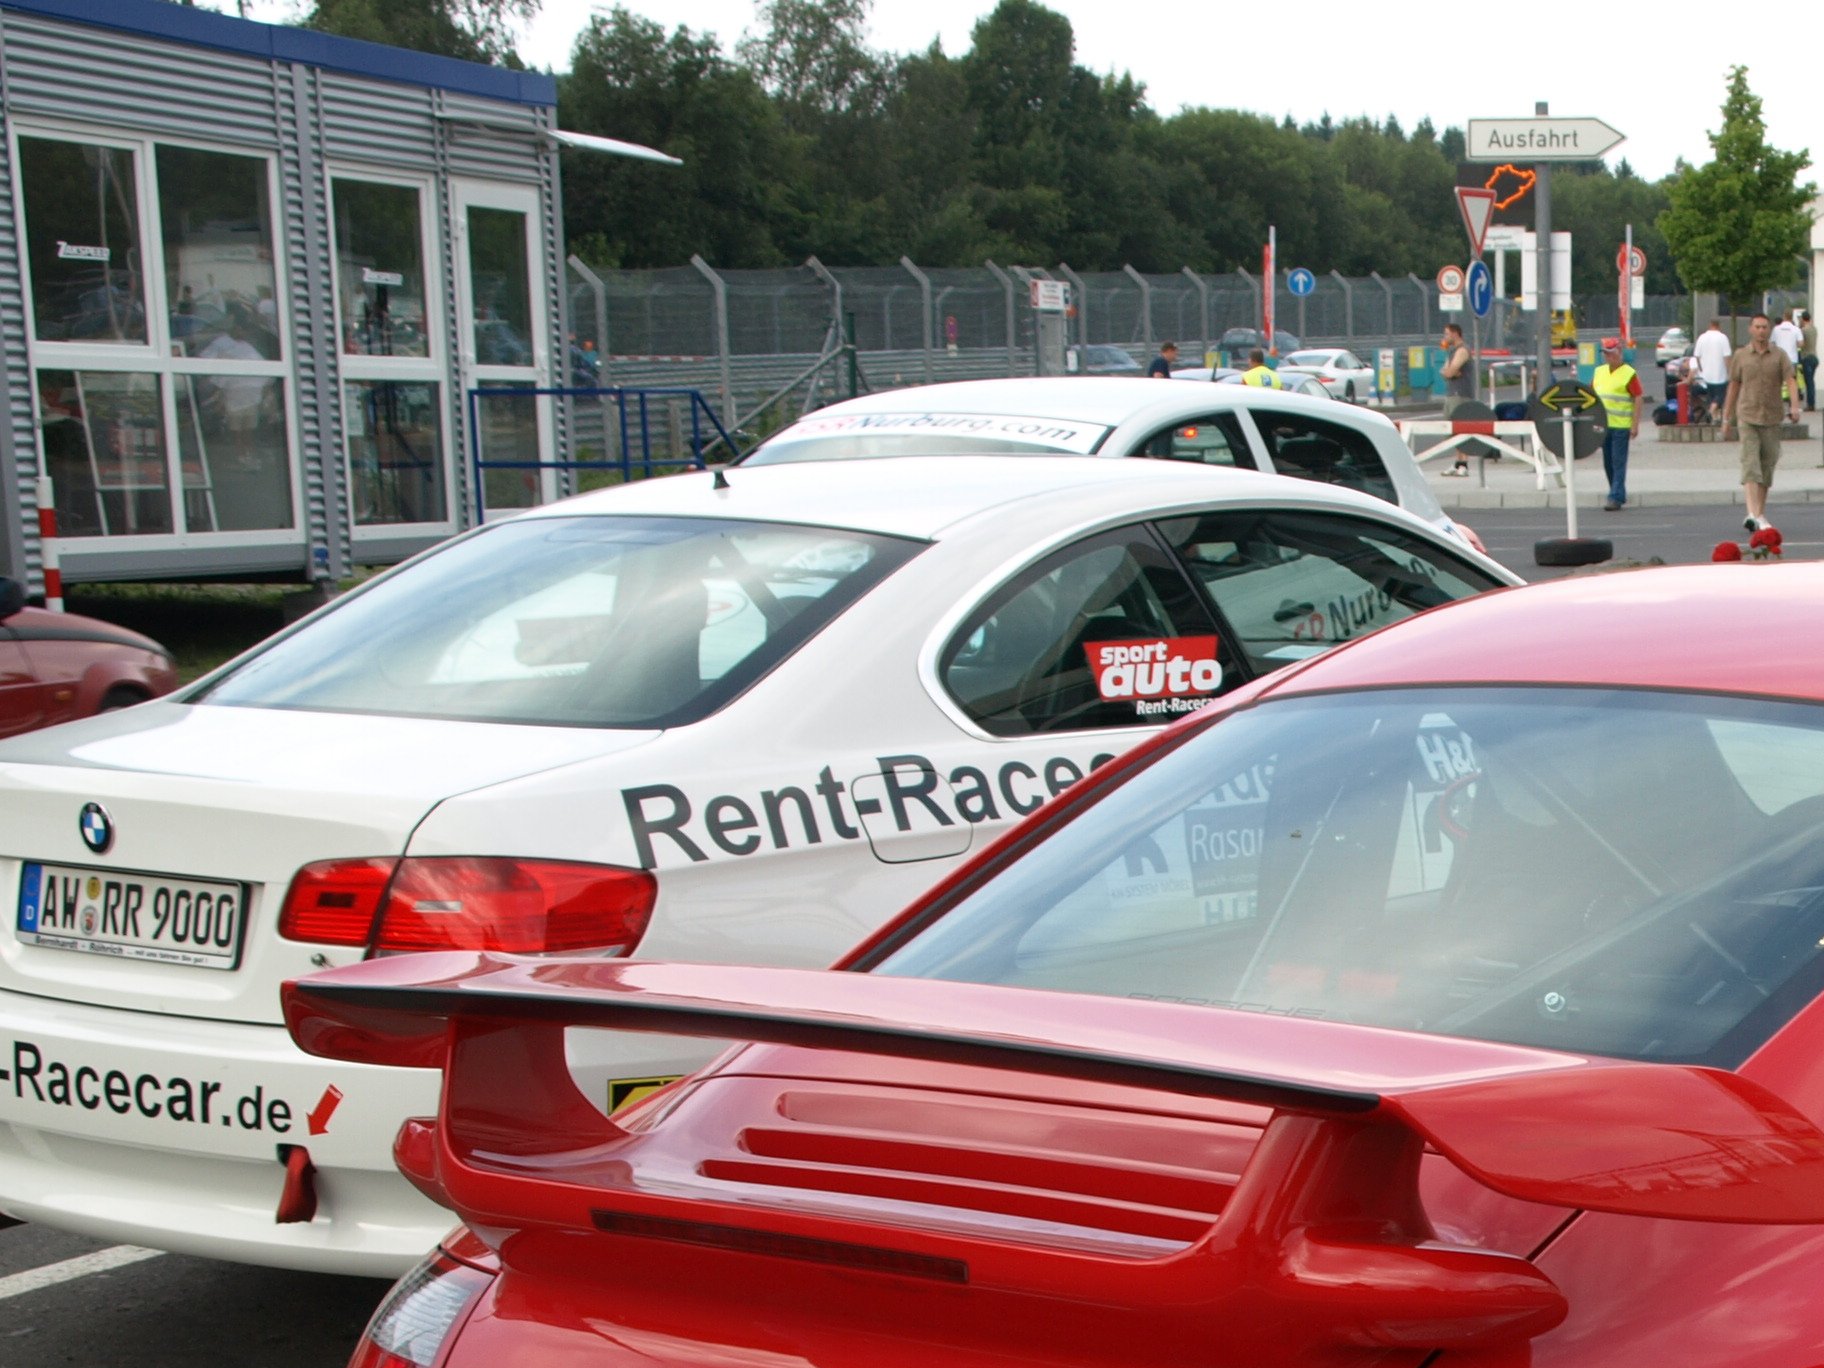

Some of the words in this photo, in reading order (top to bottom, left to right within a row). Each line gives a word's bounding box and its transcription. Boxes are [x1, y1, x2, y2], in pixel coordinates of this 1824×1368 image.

[1488, 129, 1579, 148] Ausfahrt
[1100, 641, 1168, 667] sport
[1100, 656, 1223, 698] auto
[41, 874, 80, 930] AW
[102, 881, 144, 938] RR
[152, 886, 235, 948] 9000
